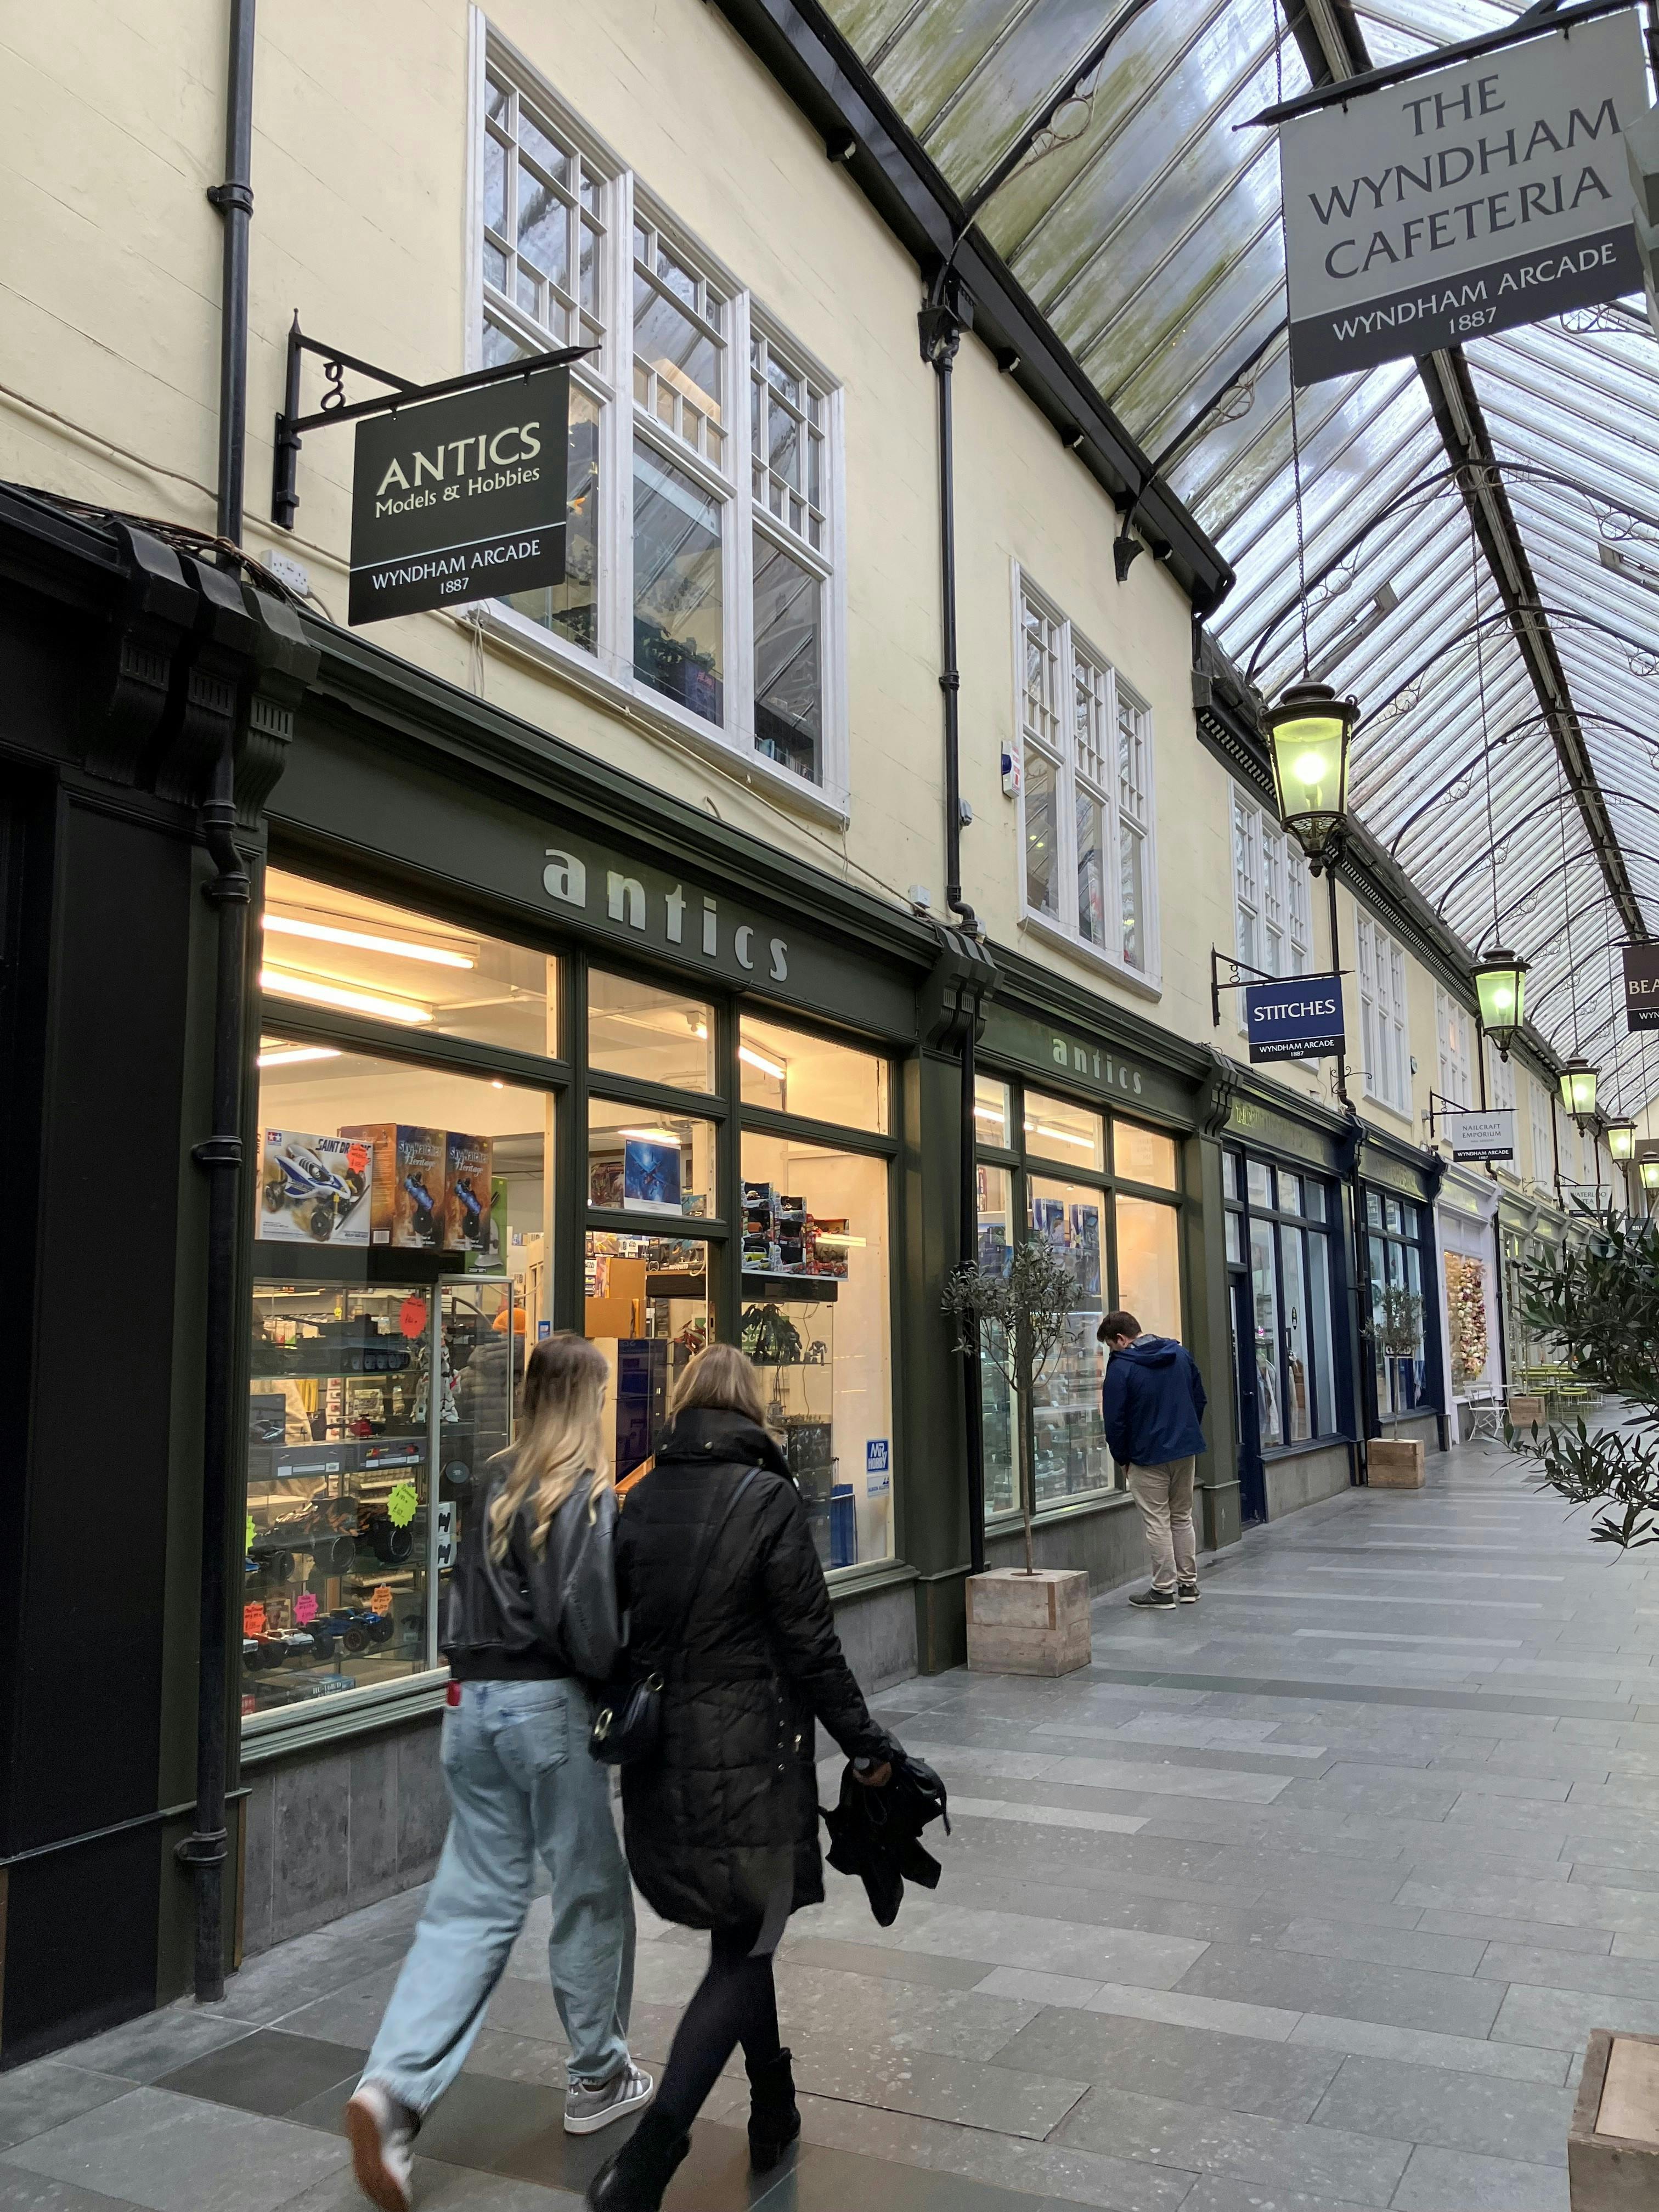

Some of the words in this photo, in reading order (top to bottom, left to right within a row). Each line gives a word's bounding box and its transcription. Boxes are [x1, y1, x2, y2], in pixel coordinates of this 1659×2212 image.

[1402, 75, 1506, 137] THE
[1307, 98, 1622, 225] WYNDHAM
[1324, 166, 1612, 279] CAFETERIA
[1333, 280, 1488, 341] WYNDHAM
[1498, 243, 1617, 296] ARCADE
[1448, 307, 1497, 334] 1887
[376, 422, 541, 495] ANTICS
[375, 489, 437, 518] Models
[443, 484, 460, 501] &
[468, 466, 540, 496] Hobbies
[372, 556, 466, 590] WYNDHAM
[471, 539, 541, 569] ARCADE
[439, 577, 469, 595] 1887
[543, 849, 788, 981] antics
[1254, 999, 1336, 1022] STITCHES
[1052, 1039, 1142, 1094] antics
[1260, 1043, 1302, 1053] WYNDHAM
[1304, 1040, 1335, 1049] ARCADE
